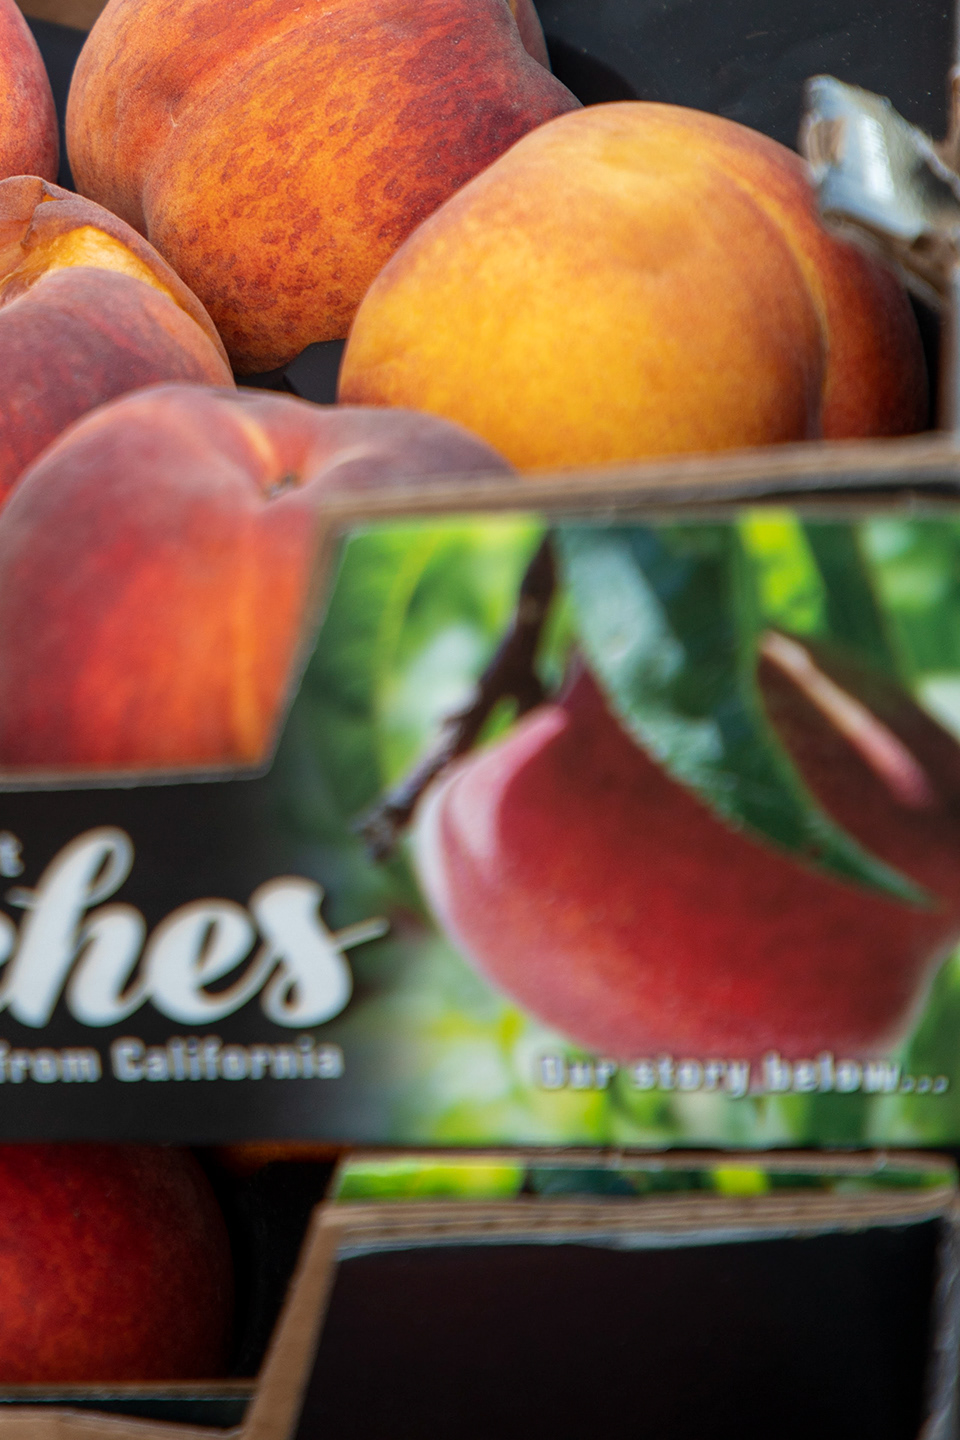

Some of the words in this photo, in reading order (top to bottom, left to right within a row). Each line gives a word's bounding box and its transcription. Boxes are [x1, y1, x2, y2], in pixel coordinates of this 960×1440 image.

[110, 1035, 345, 1083] California
[539, 1054, 618, 1090] Our
[632, 1051, 751, 1099] story
